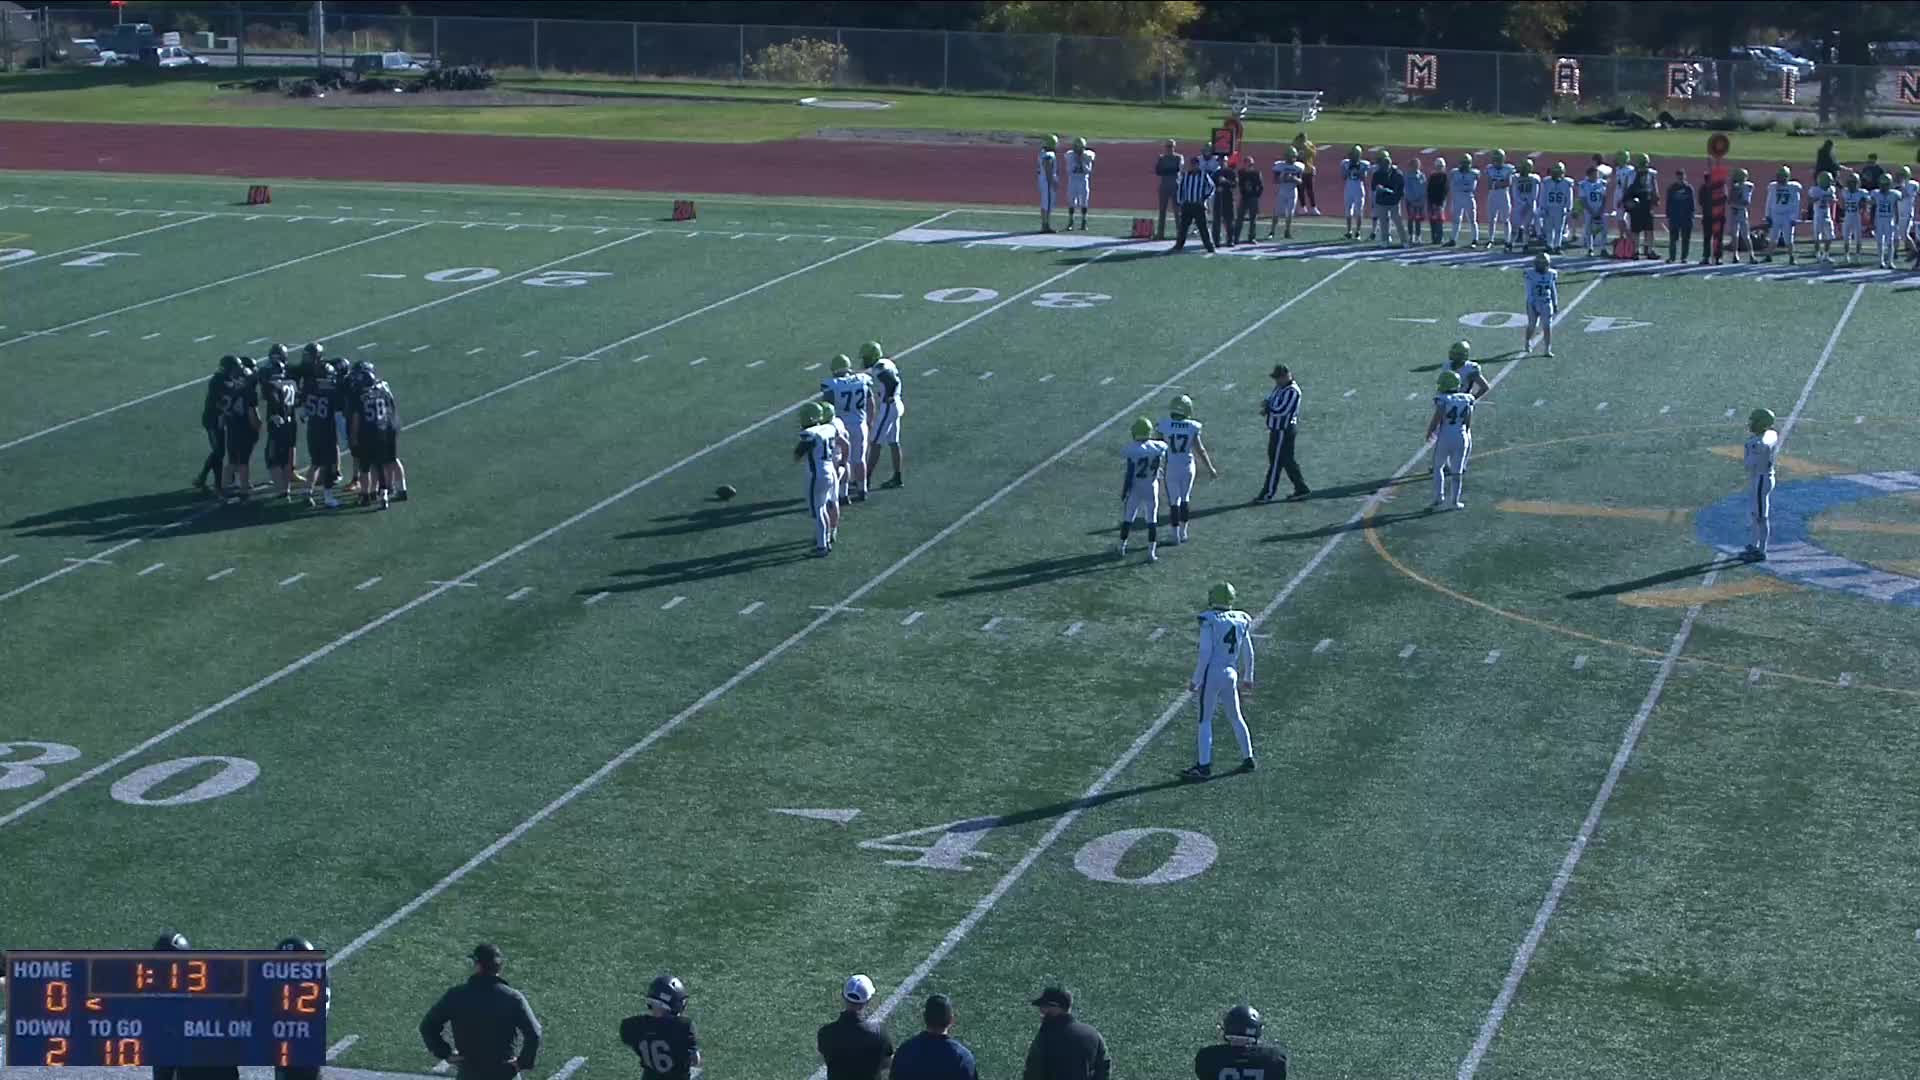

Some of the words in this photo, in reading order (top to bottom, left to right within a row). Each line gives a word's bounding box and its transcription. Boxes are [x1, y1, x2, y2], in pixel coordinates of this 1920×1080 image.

[841, 390, 865, 411] 72
[1168, 434, 1188, 453] 17
[1223, 625, 1237, 653] 4
[640, 1040, 673, 1072] 16
